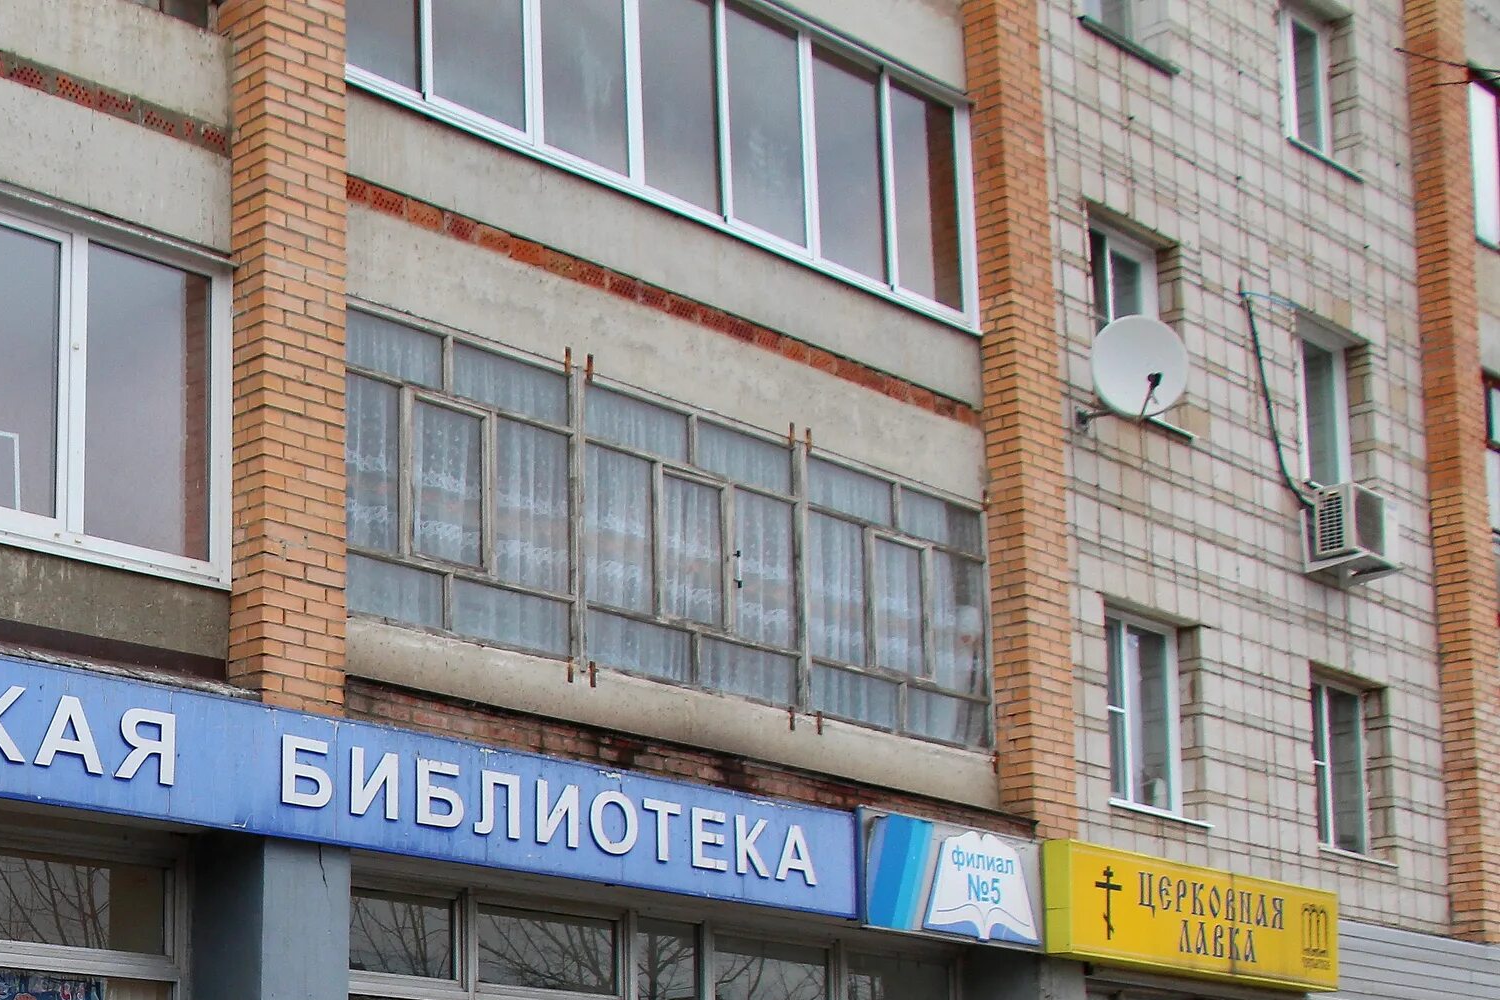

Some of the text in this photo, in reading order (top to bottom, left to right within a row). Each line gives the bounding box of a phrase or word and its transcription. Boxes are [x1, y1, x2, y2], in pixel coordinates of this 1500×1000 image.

[280, 733, 818, 886] БИБЛИОТЕКА
[951, 845, 1014, 874] филиал
[967, 873, 1001, 904] №5
[1138, 871, 1285, 930] ЦЕРКОВНАЯ
[1179, 919, 1257, 962] ЛАВКА
